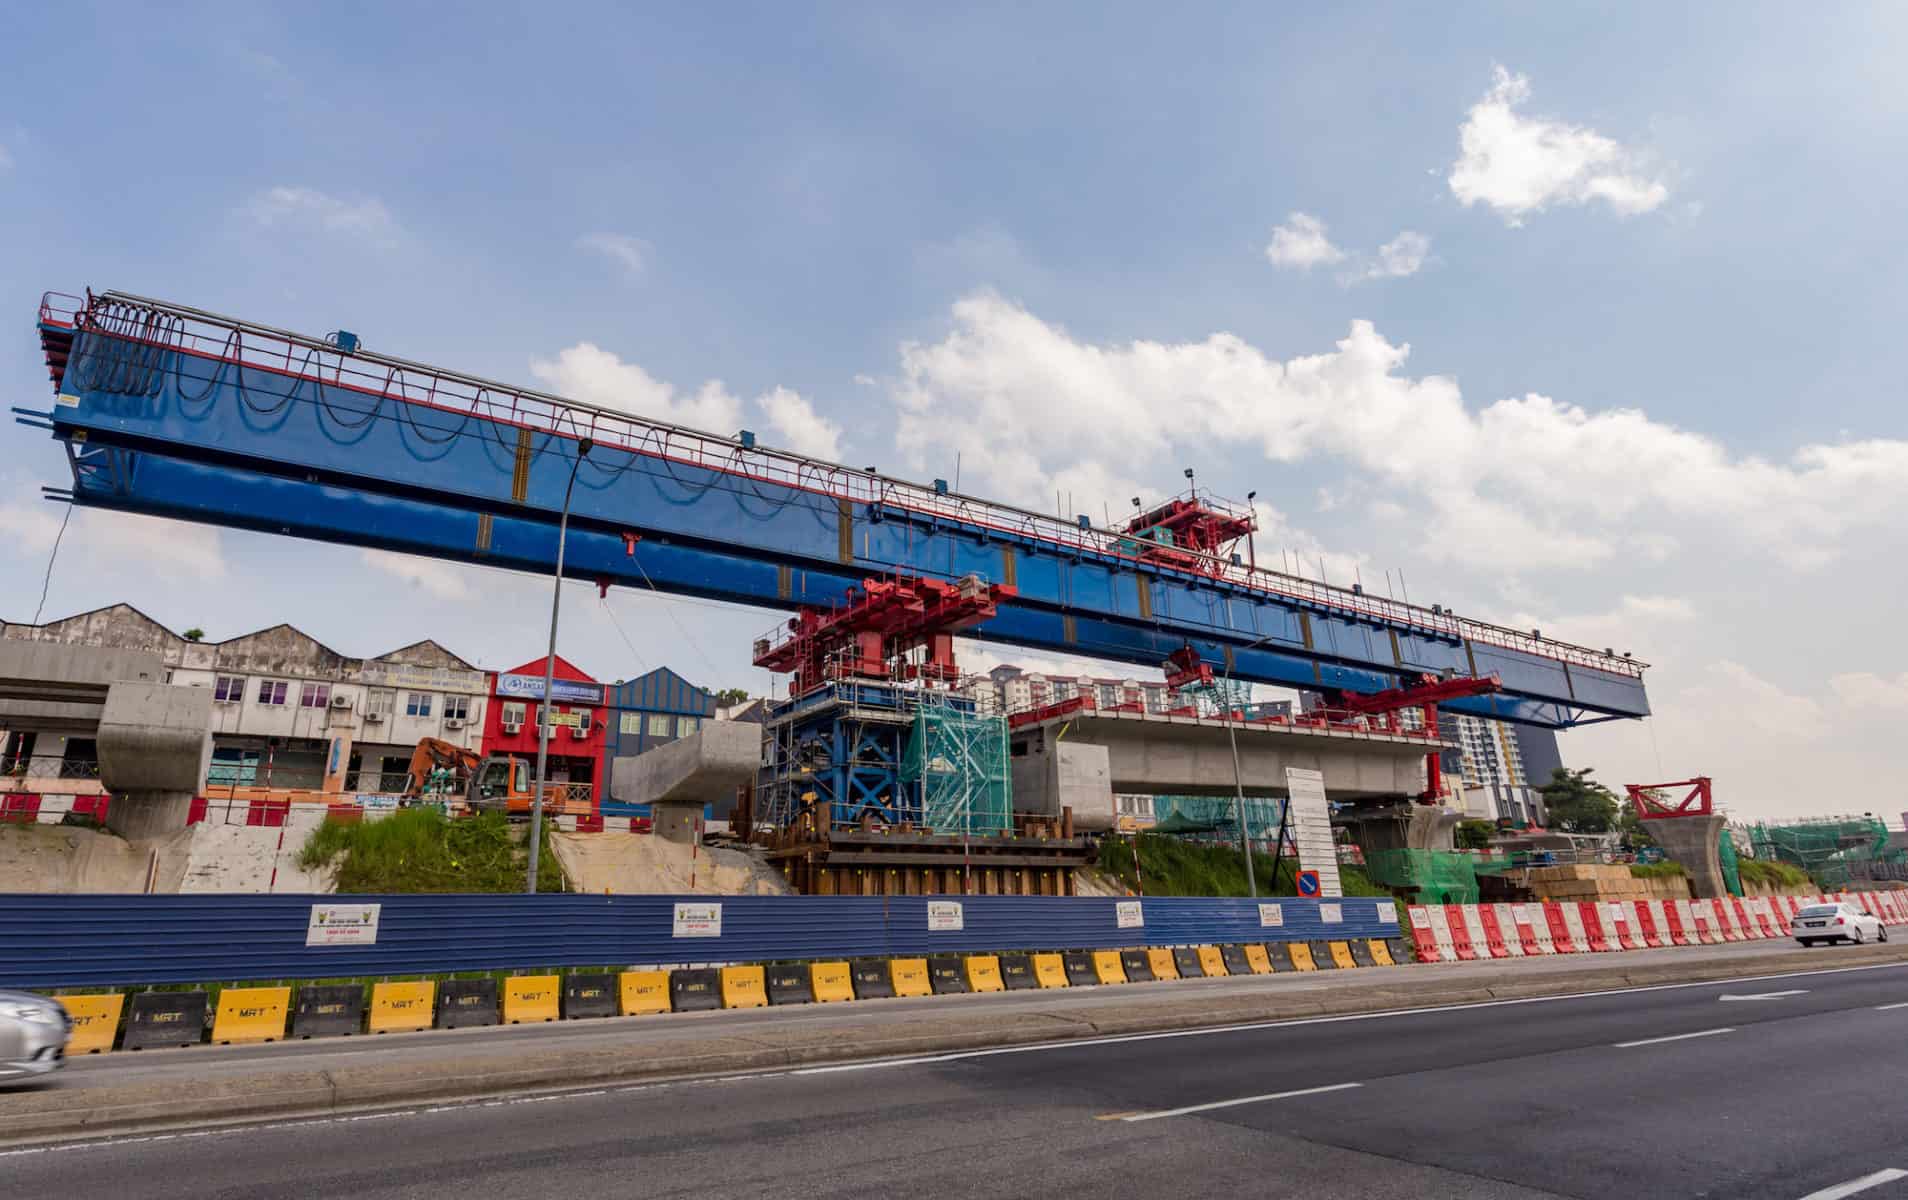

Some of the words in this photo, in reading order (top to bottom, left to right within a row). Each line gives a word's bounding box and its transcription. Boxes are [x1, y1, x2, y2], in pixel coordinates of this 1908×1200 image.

[636, 986, 655, 995] MRT
[687, 984, 705, 992] MRT
[522, 992, 542, 1001] MRT
[581, 990, 600, 998] MRT
[391, 1000, 414, 1009] MRT
[152, 1012, 184, 1022] MRT
[239, 1008, 266, 1017] MRT
